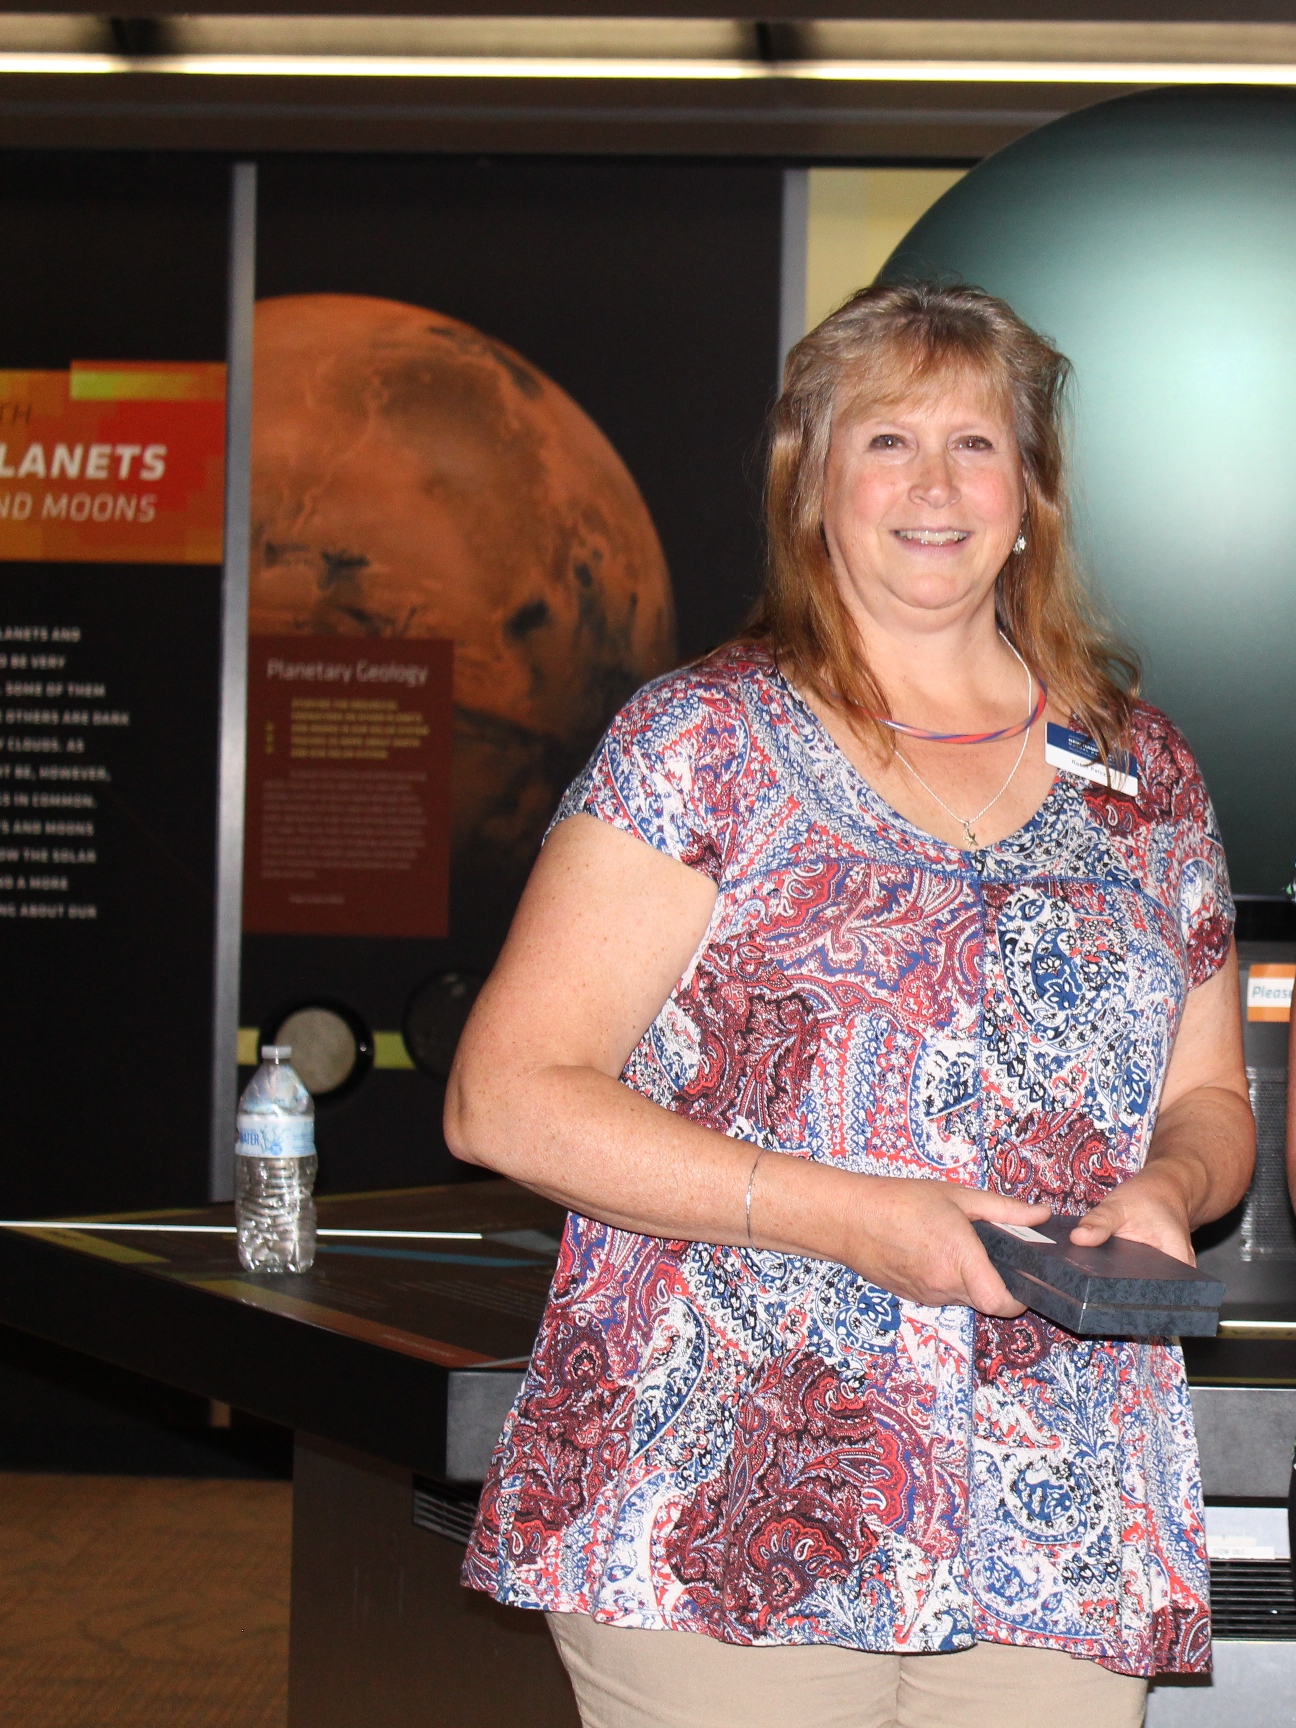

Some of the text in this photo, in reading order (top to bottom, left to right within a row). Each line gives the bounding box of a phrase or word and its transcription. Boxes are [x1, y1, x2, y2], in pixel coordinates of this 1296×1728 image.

[0, 442, 167, 480] LANETS
[41, 492, 156, 522] MOONS
[51, 627, 81, 642] AND
[266, 657, 428, 687] Planetary Geology
